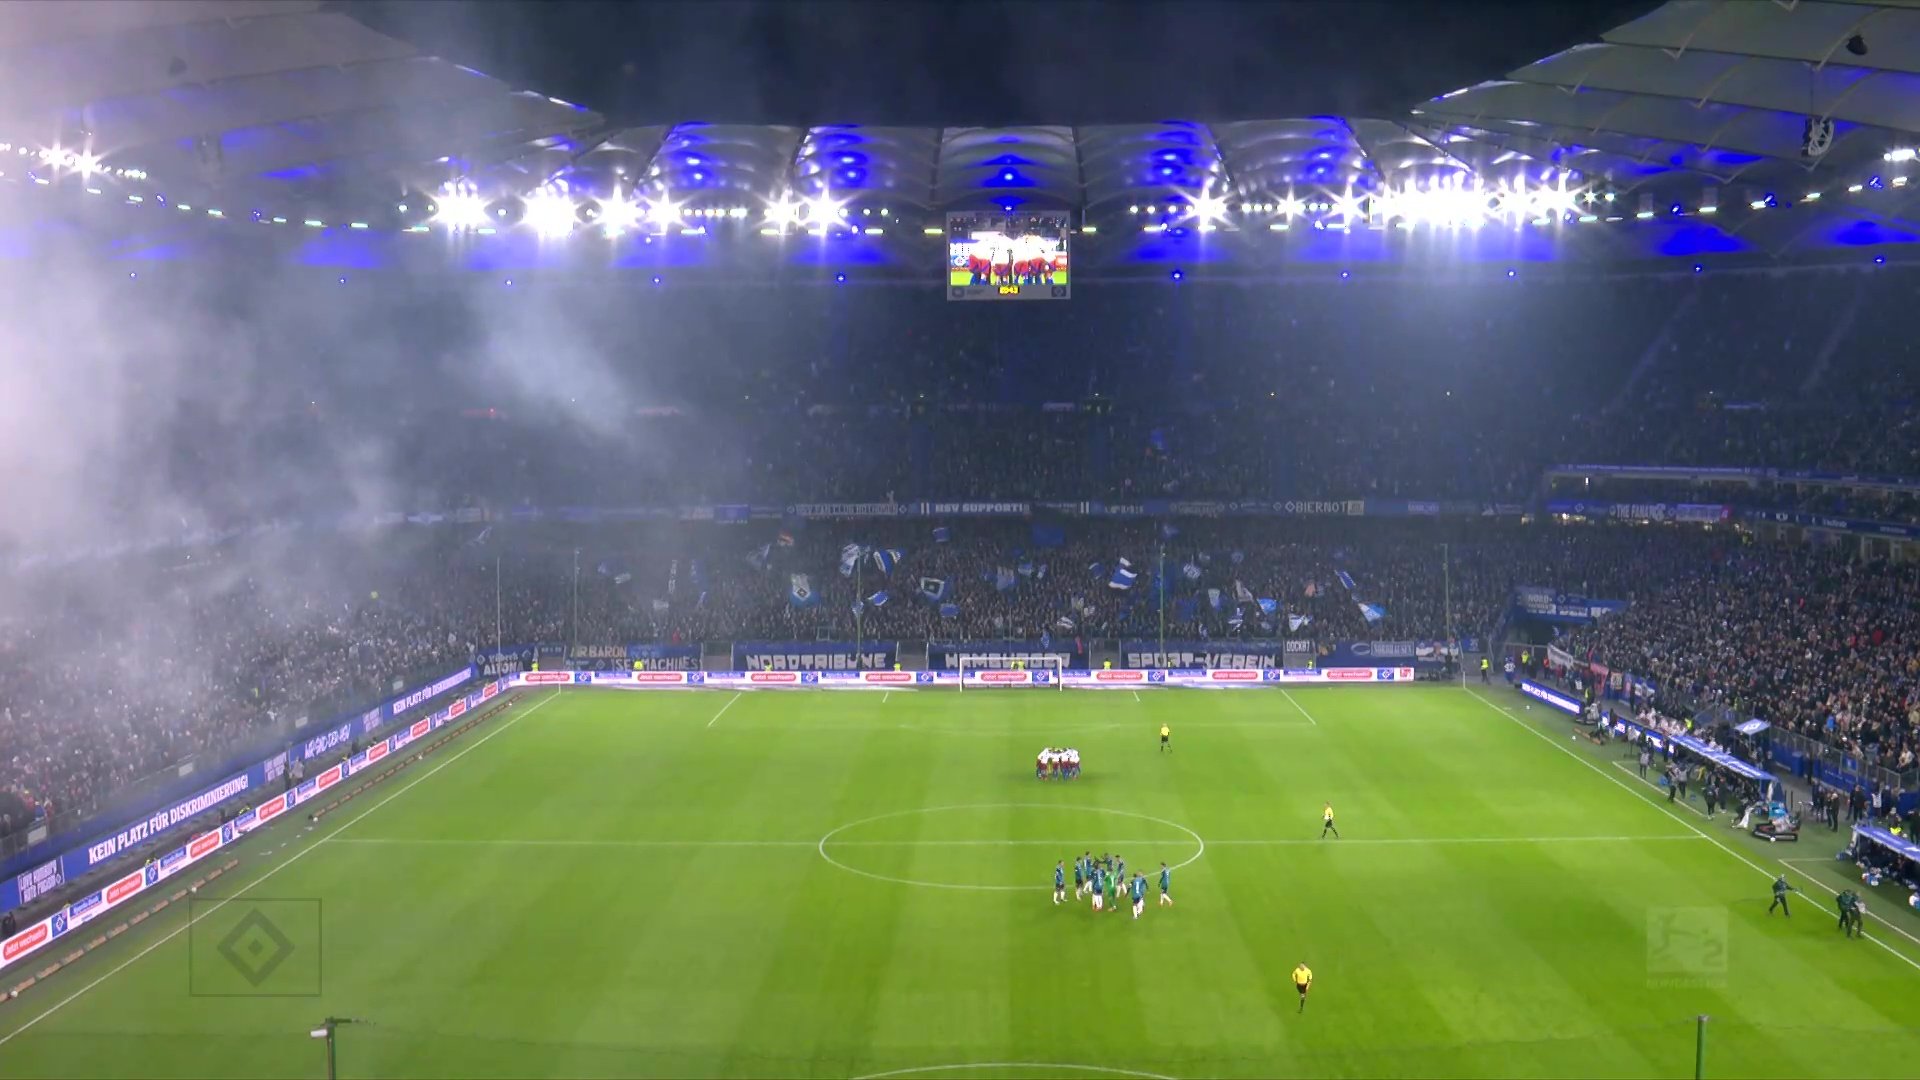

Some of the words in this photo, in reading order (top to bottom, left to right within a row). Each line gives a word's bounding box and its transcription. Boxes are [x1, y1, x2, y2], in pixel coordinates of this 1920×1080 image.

[88, 838, 116, 865] KEIN
[117, 821, 149, 851] PLATZ
[150, 811, 170, 835] FÜR
[170, 773, 249, 825] DISKRIMINIERUNG!
